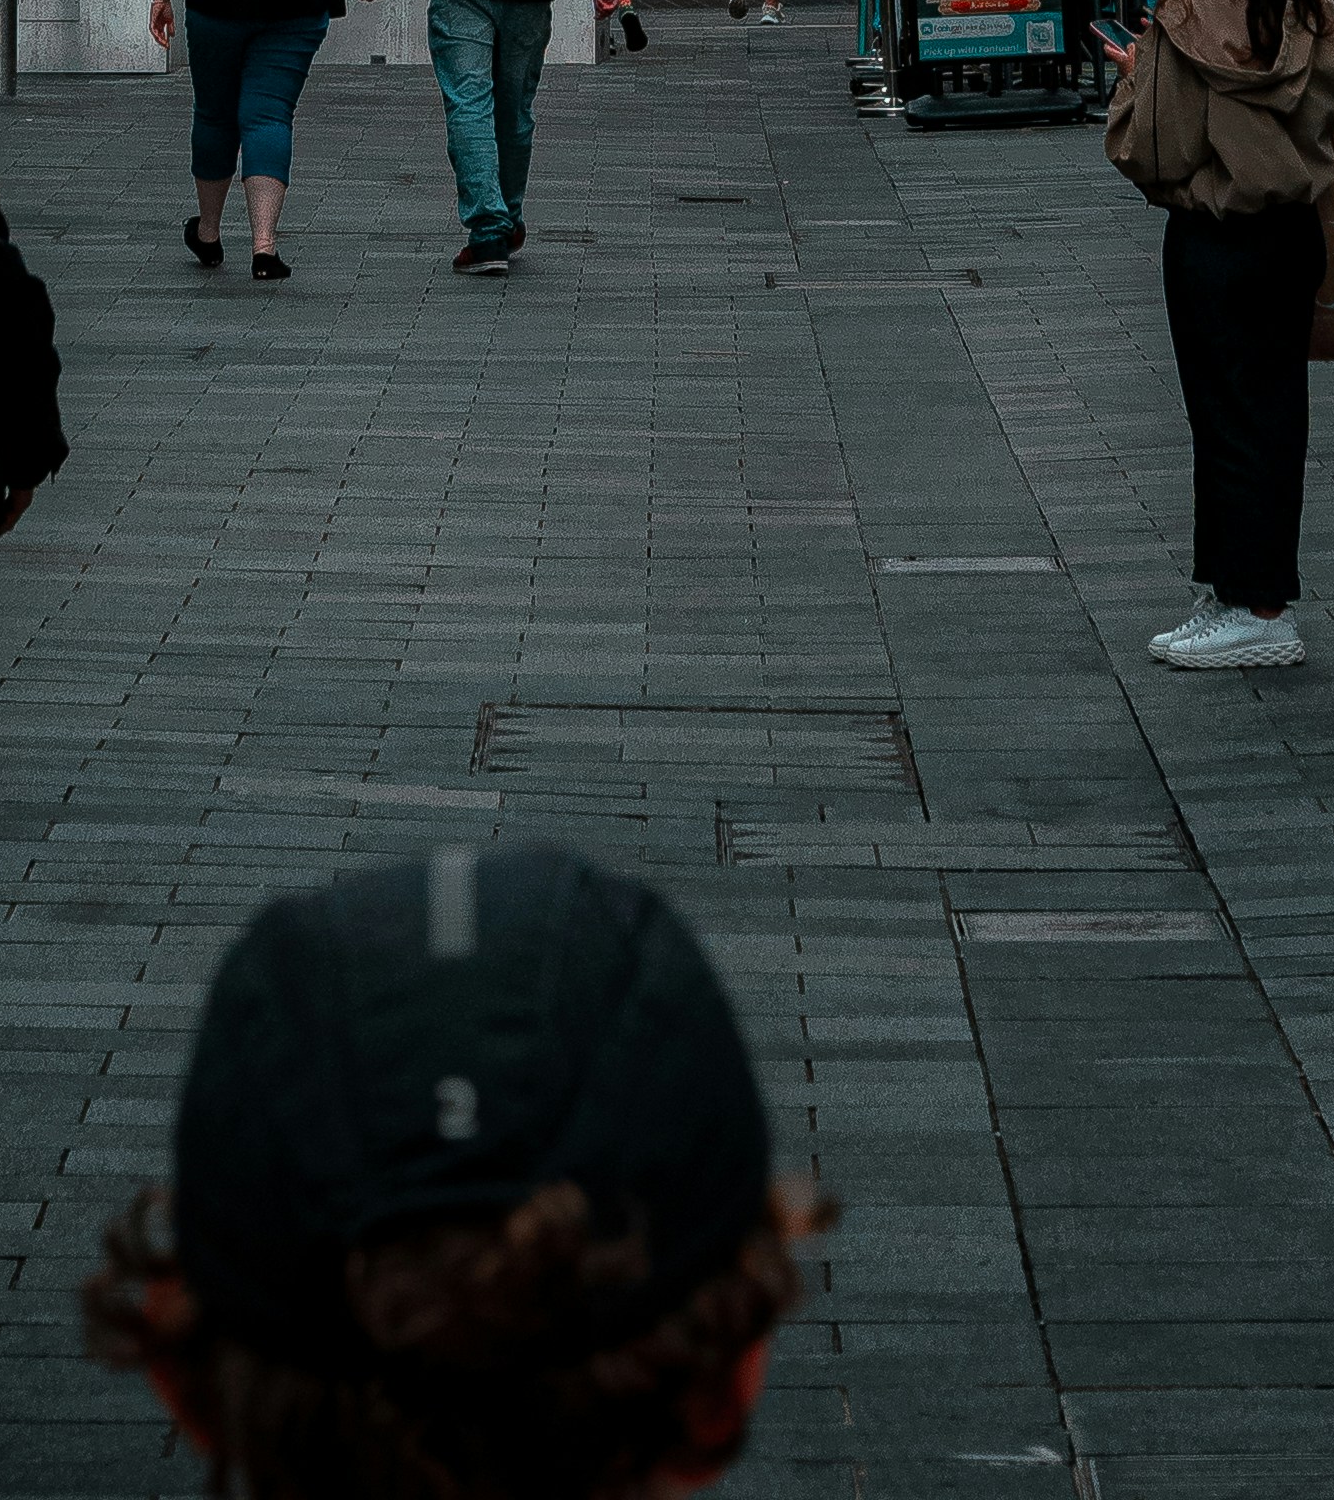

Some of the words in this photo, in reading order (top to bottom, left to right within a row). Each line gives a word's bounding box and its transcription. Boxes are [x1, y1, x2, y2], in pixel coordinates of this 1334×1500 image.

[923, 47, 943, 56] Pick
[943, 48, 956, 57] up
[957, 46, 978, 55] with
